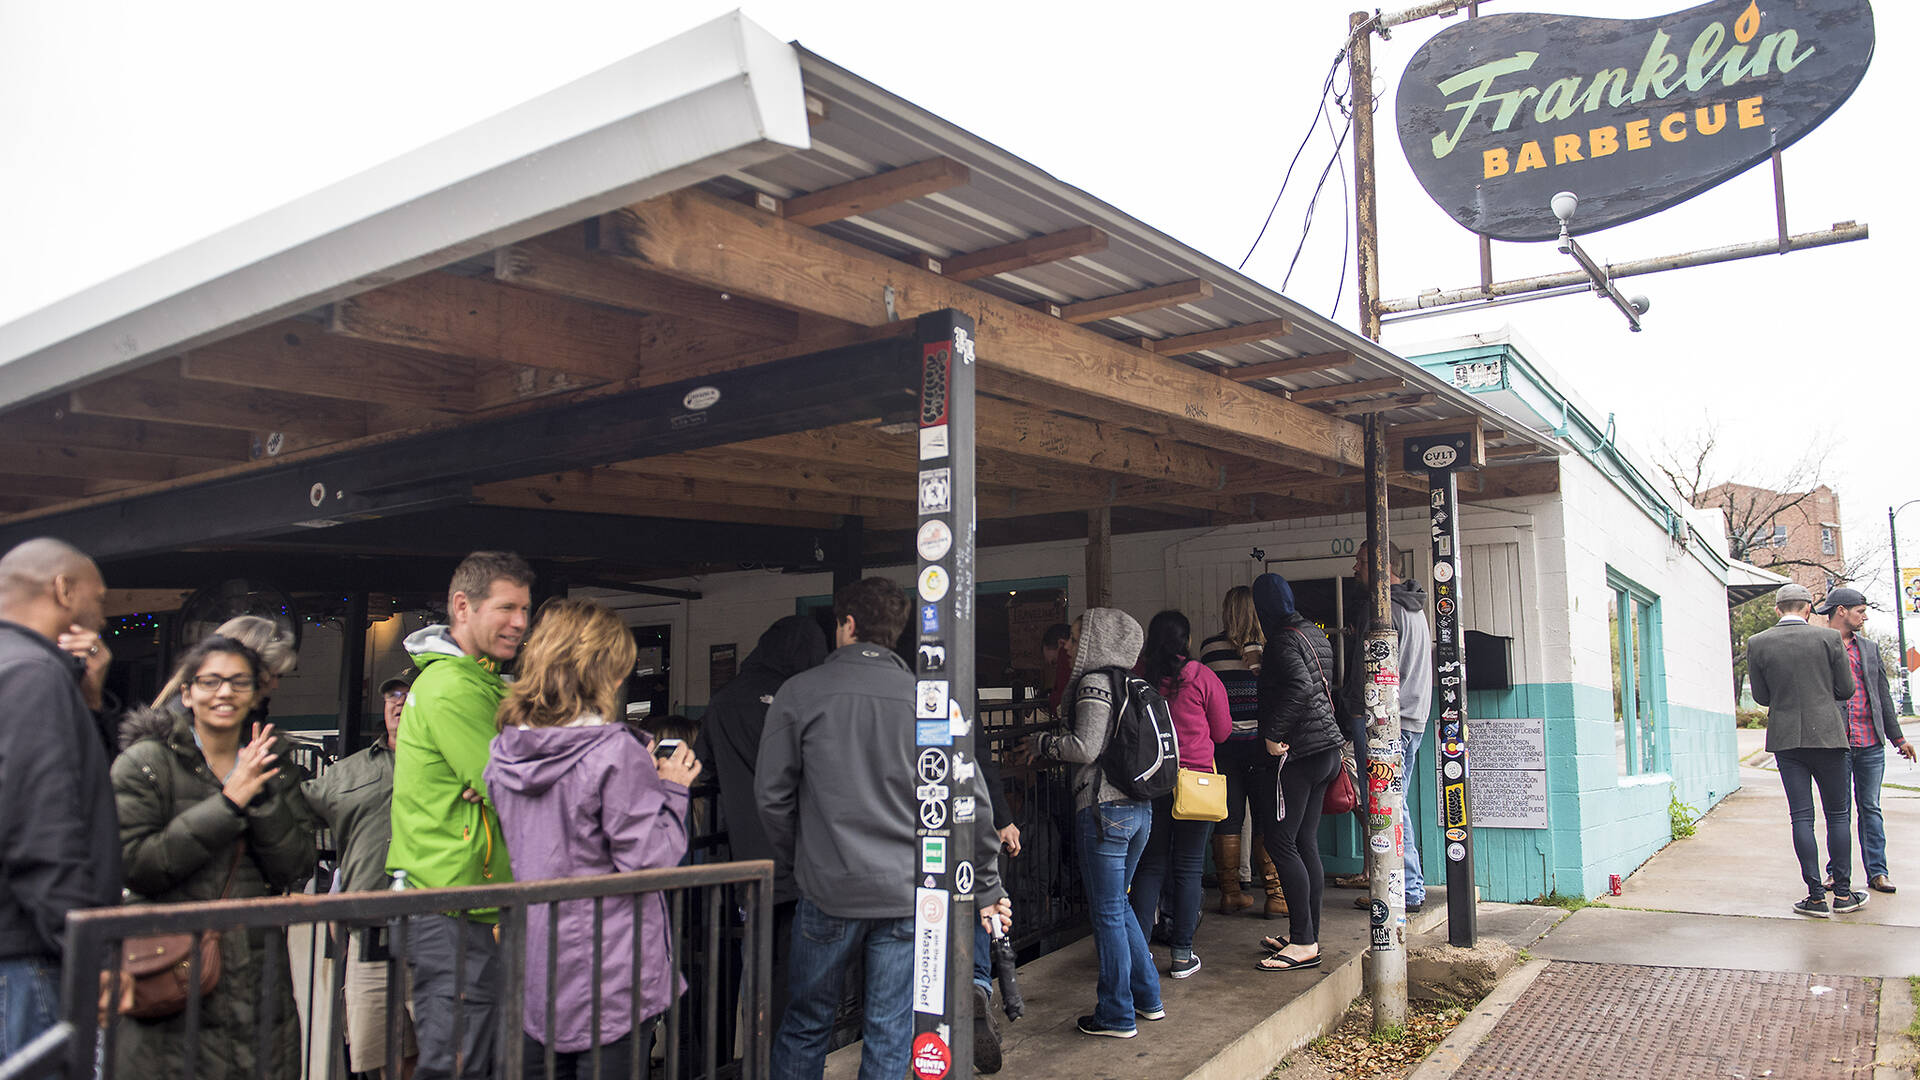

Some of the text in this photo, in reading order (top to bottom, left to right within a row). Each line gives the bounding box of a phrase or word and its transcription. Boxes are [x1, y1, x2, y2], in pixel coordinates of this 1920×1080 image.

[1431, 22, 1815, 159] Franklin
[1483, 95, 1766, 179] BARBECUE
[920, 928, 932, 1008] MasterChef
